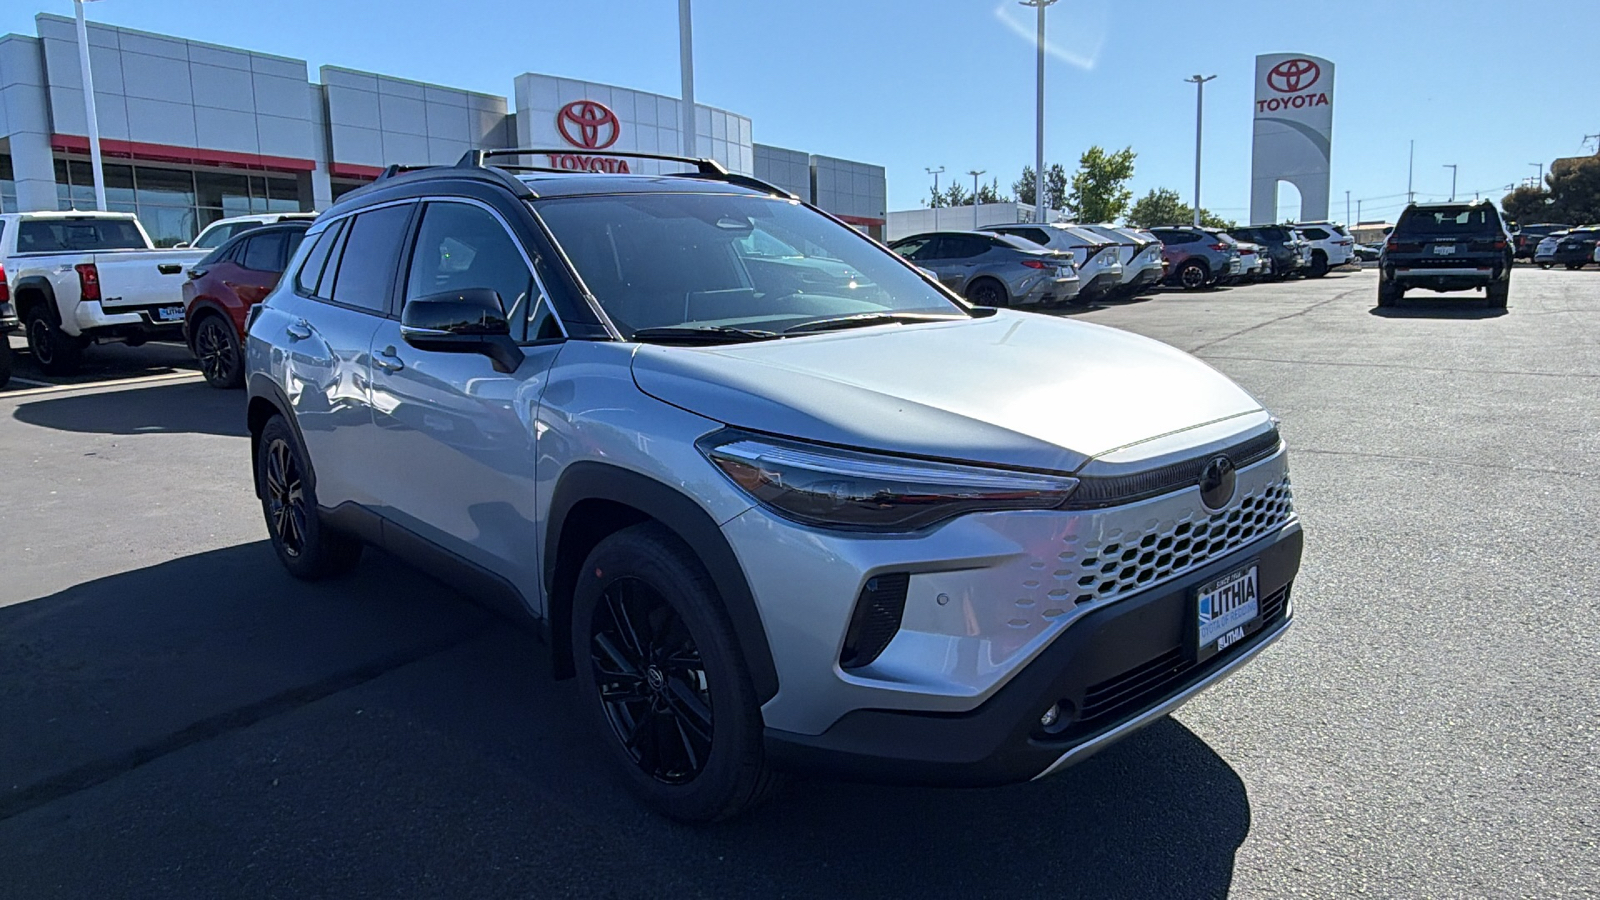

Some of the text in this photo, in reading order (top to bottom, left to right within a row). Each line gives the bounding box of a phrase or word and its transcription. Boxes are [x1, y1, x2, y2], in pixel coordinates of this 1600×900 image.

[1257, 93, 1329, 112] TOYOTA
[548, 153, 631, 174] TOYOTA
[1211, 576, 1255, 620] LITHIA
[1224, 626, 1245, 648] LITHIA
